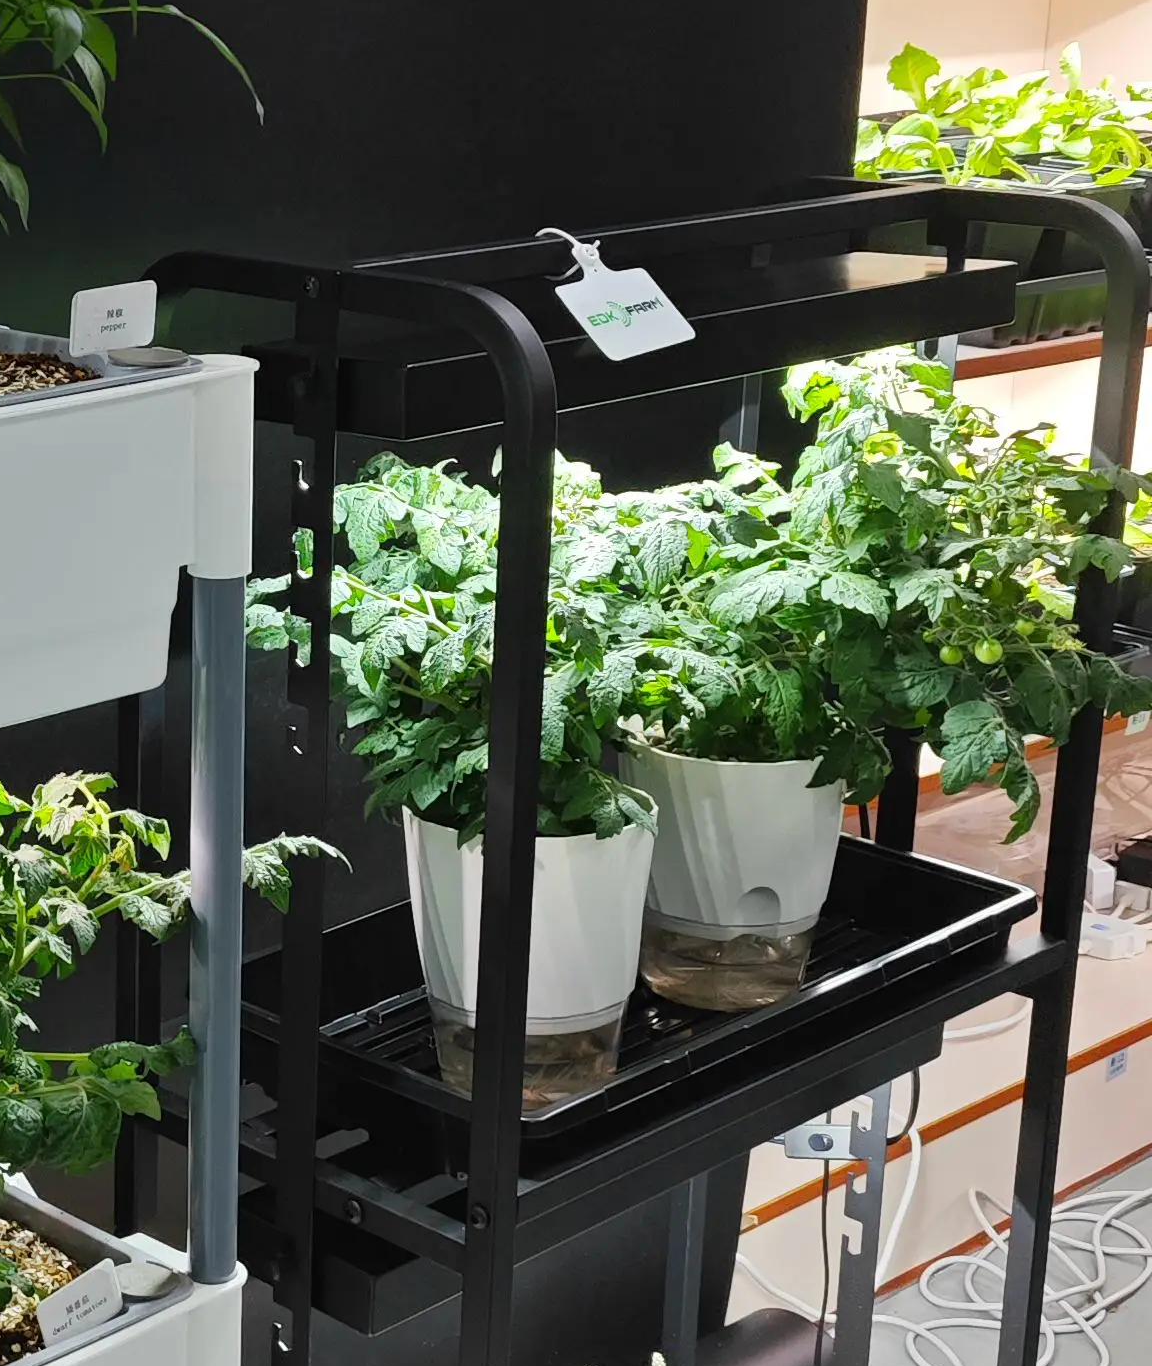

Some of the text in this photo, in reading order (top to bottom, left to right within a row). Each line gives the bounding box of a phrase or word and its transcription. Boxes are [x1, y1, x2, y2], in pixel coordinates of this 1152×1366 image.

[587, 296, 663, 327] EDK FARM
[100, 322, 127, 334] pepper
[52, 1317, 73, 1336] dwarf
